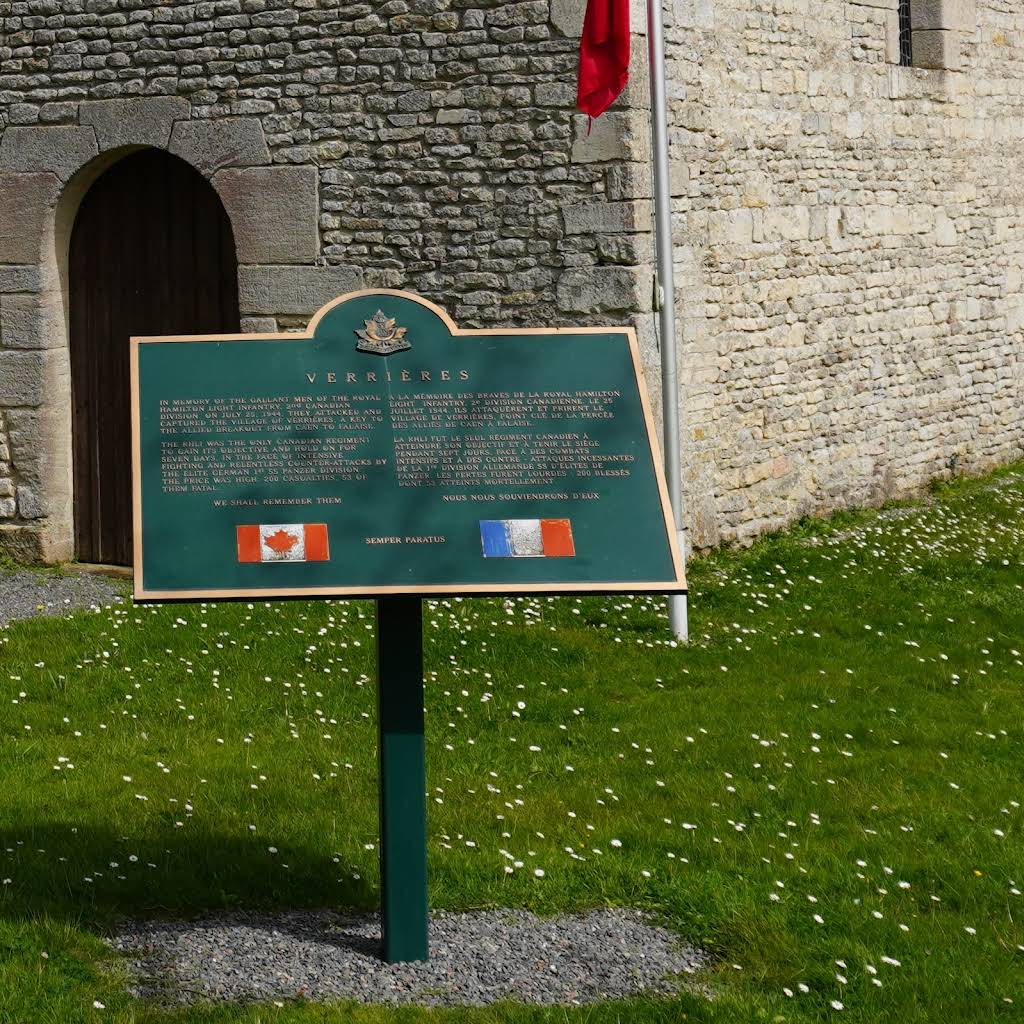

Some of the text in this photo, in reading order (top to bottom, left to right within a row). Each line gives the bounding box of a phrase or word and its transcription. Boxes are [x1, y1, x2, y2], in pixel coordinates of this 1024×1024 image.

[307, 369, 470, 384] VERRIÈRES
[575, 390, 621, 398] HAMILTON
[172, 398, 210, 406] MEMORY
[250, 396, 289, 404] GALLANT
[305, 402, 351, 410] CANADIAN
[315, 409, 360, 417] ATTACKED
[231, 418, 267, 426] VILLAGE
[276, 438, 322, 446] CANADIAN
[326, 437, 370, 445] REGIMENT
[220, 446, 268, 454] OBJECTIVE
[395, 450, 435, 458] PENDANT
[298, 452, 343, 460] INTENSIVE
[530, 455, 574, 463] ATTAQUES
[230, 461, 284, 469] RELENTLESS
[288, 459, 372, 467] COUNTER-ATTACKS
[594, 468, 631, 476] BLESSÉS
[484, 478, 554, 486] MORTELLEMENT
